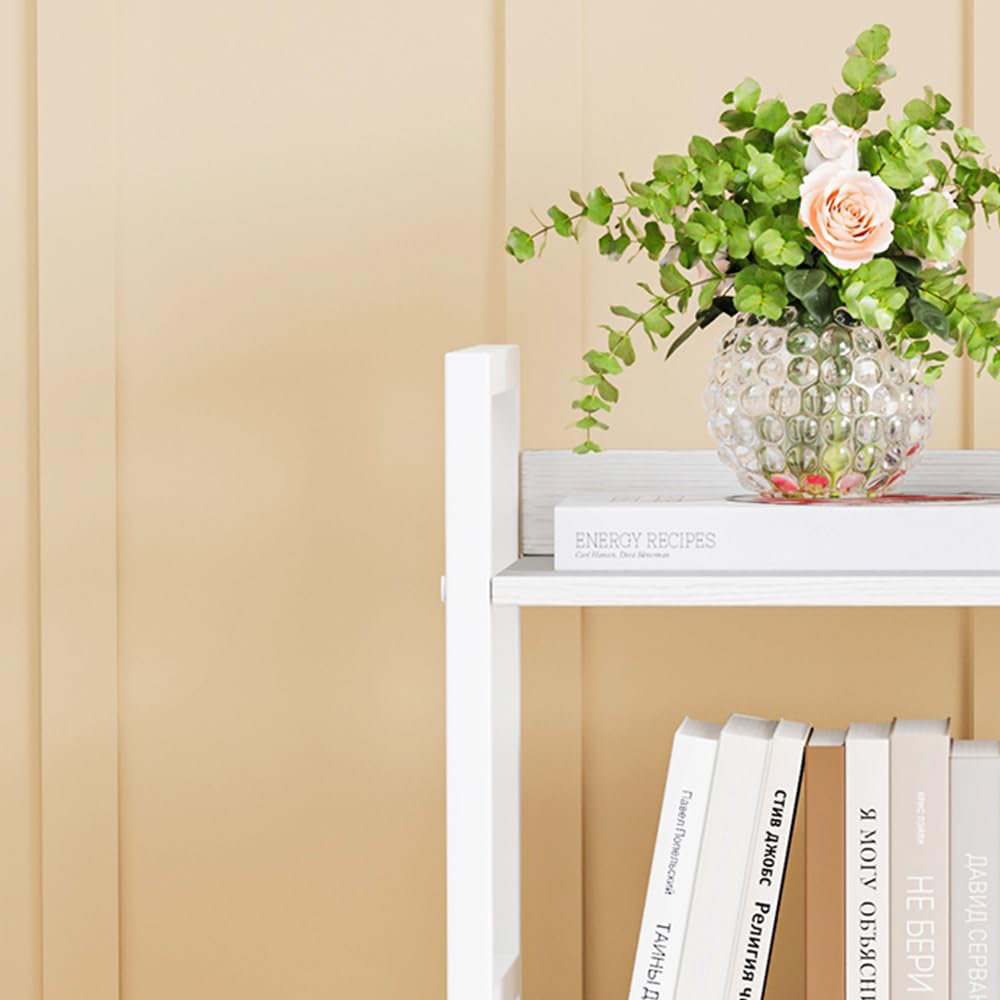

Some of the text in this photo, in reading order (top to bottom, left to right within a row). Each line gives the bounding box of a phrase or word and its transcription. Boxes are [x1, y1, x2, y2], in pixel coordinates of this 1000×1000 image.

[575, 532, 717, 549] ENERGY RECIPES
[664, 789, 693, 895] Павел Попельский
[859, 808, 877, 821] Я
[859, 829, 877, 890] МОГУ
[964, 852, 988, 924] ДАВИД
[905, 875, 935, 911] НЕ
[742, 902, 771, 982] Религия
[905, 919, 935, 992] БЕРИ
